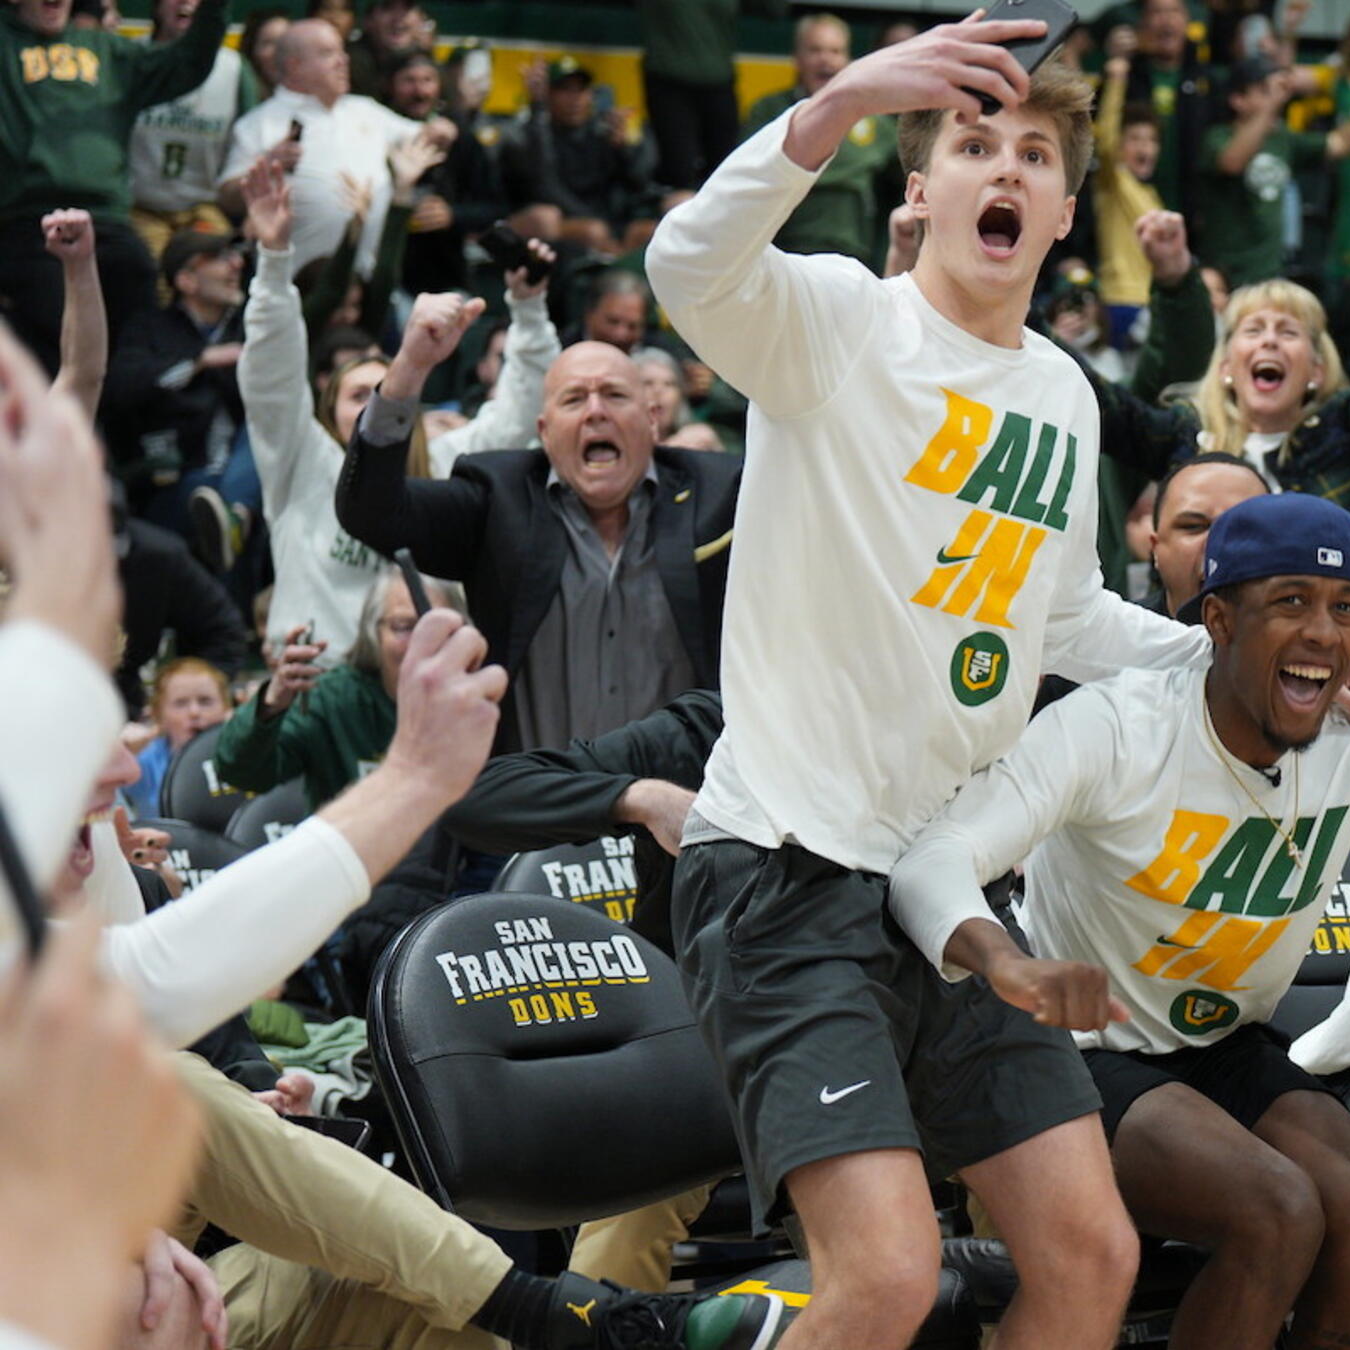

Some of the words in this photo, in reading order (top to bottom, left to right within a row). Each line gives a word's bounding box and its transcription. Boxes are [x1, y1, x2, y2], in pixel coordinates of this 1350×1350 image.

[903, 386, 1077, 533] BALL
[909, 509, 1048, 630] IN
[1123, 805, 1350, 917] BALL
[435, 934, 648, 999] FRANCISCO
[494, 917, 553, 944] SAN
[1130, 910, 1292, 991] IN
[508, 991, 598, 1027] DONS
